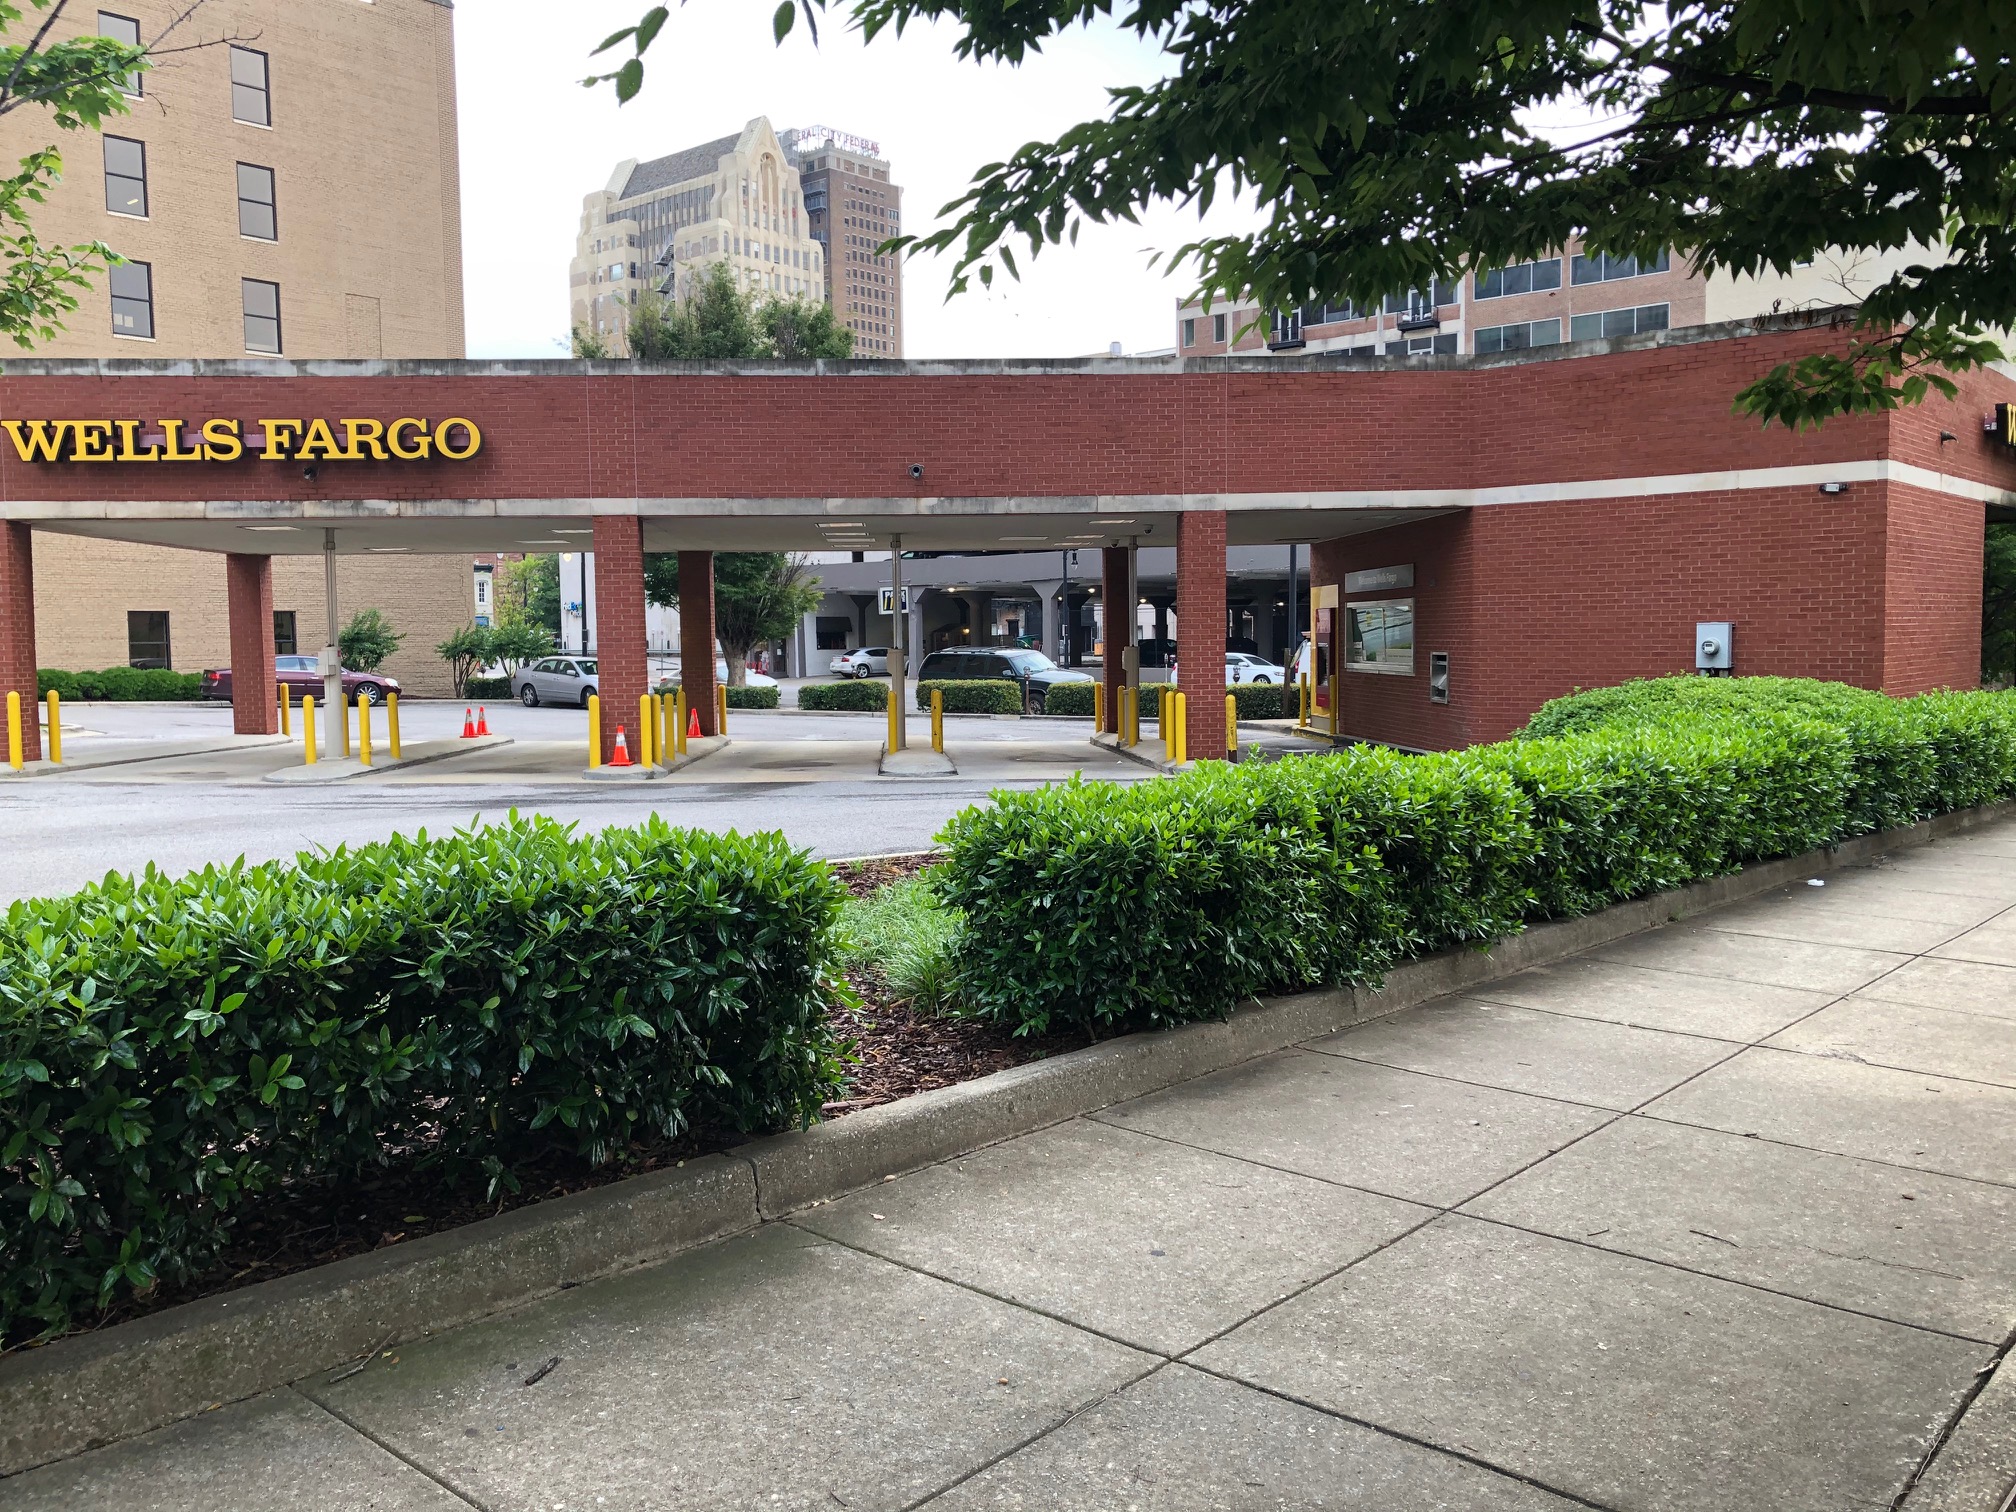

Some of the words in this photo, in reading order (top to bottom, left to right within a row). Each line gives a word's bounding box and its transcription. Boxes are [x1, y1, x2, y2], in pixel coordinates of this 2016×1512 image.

[798, 128, 816, 141] ERAL
[821, 127, 842, 142] CITY
[0, 419, 243, 462] WELLS
[258, 417, 482, 461] FARGO
